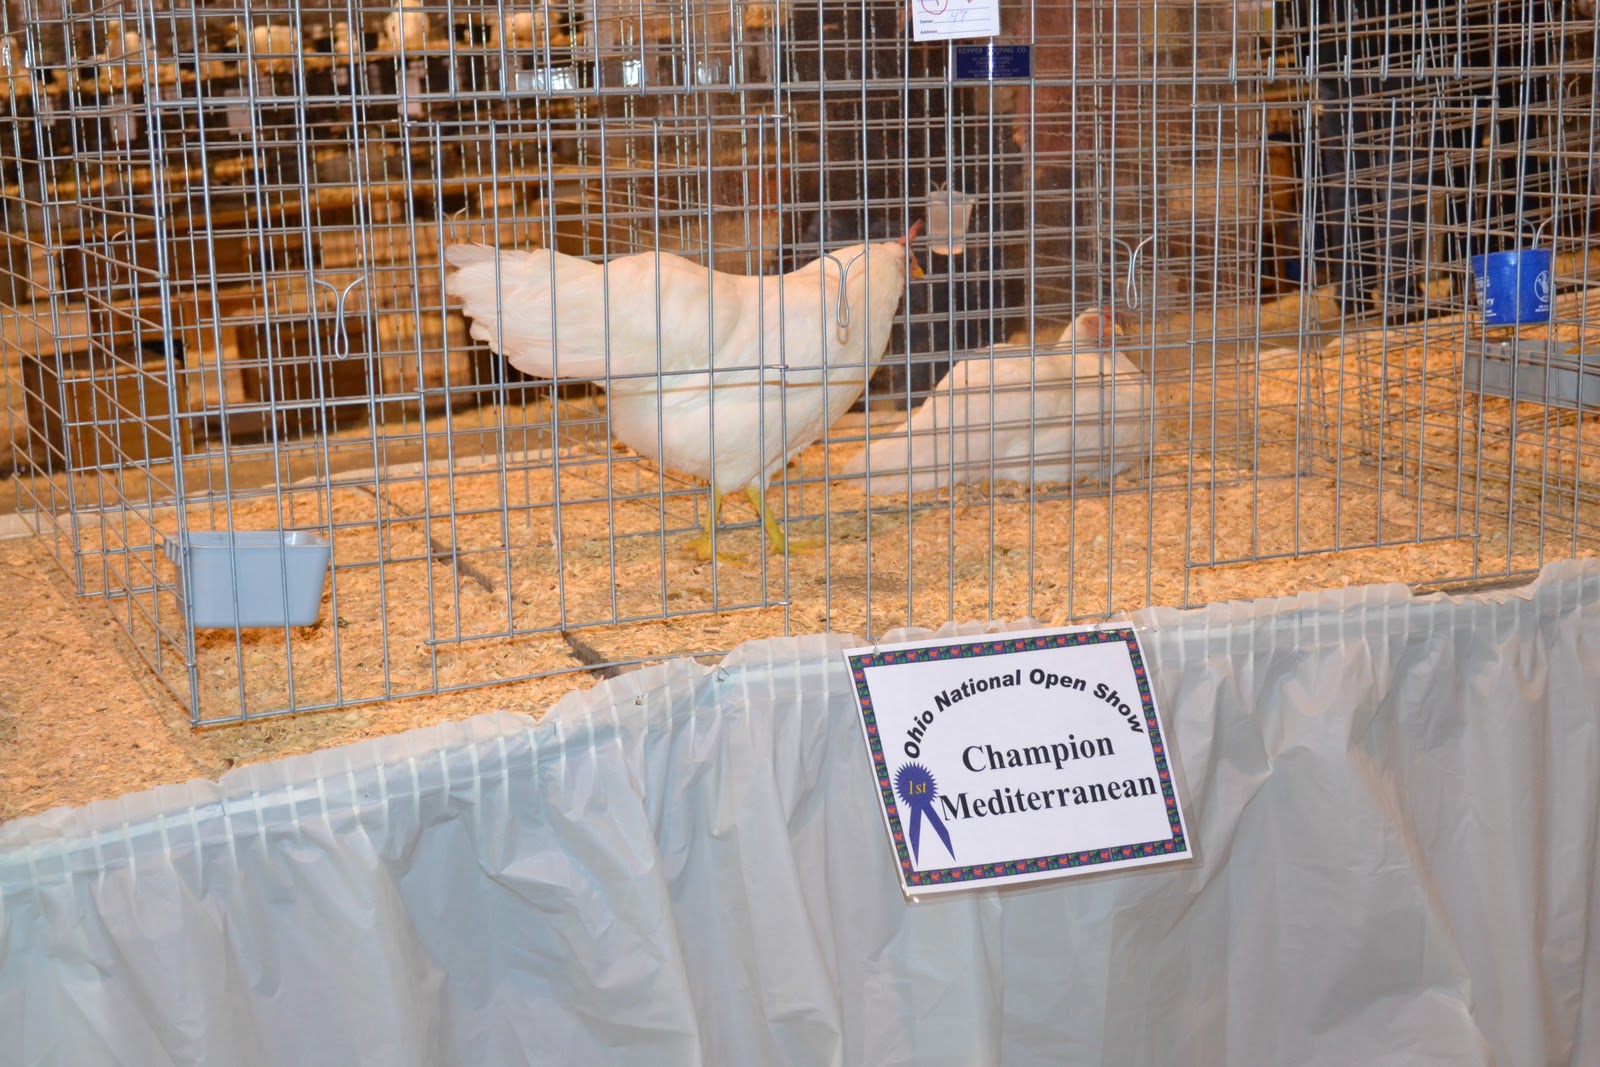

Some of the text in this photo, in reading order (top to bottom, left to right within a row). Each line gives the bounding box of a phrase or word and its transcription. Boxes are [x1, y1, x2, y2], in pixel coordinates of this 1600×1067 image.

[904, 668, 1144, 759] Ohio National Open Show
[962, 734, 1115, 773] Champion
[908, 779, 928, 795] 1st
[938, 775, 1158, 821] Mediterranean
